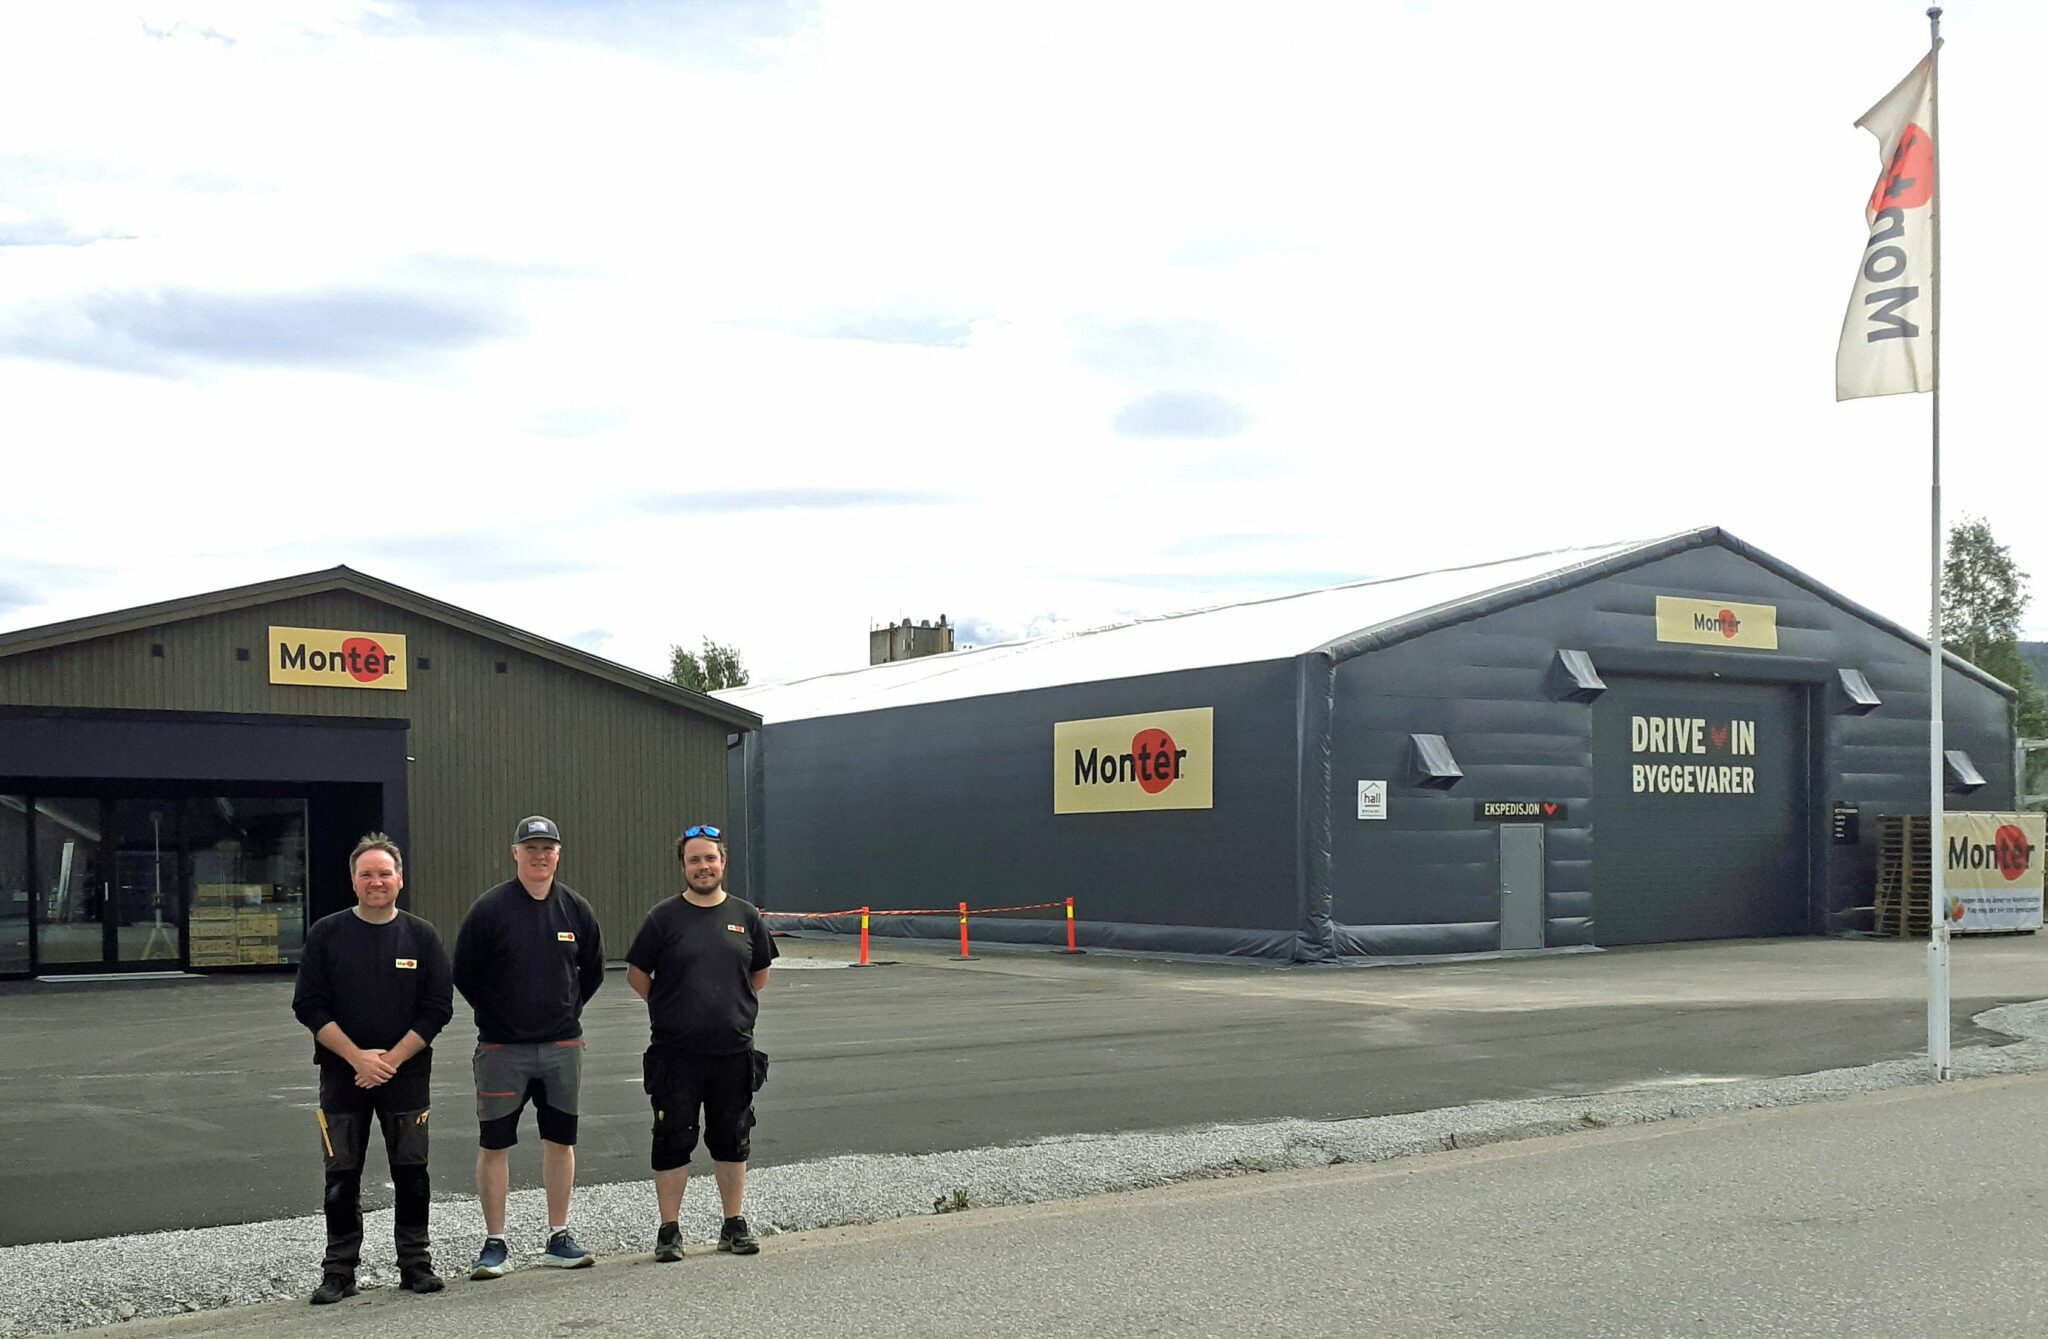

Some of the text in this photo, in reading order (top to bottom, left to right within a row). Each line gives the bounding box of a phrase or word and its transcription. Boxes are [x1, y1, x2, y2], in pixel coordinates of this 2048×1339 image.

[280, 642, 396, 675] Montér
[1631, 715, 1756, 756] DRIVE IN
[1074, 738, 1187, 786] Montér
[1631, 764, 1755, 794] BYGGEVARER
[1363, 792, 1381, 804] hall
[1484, 802, 1540, 816] EKSPEDISJON
